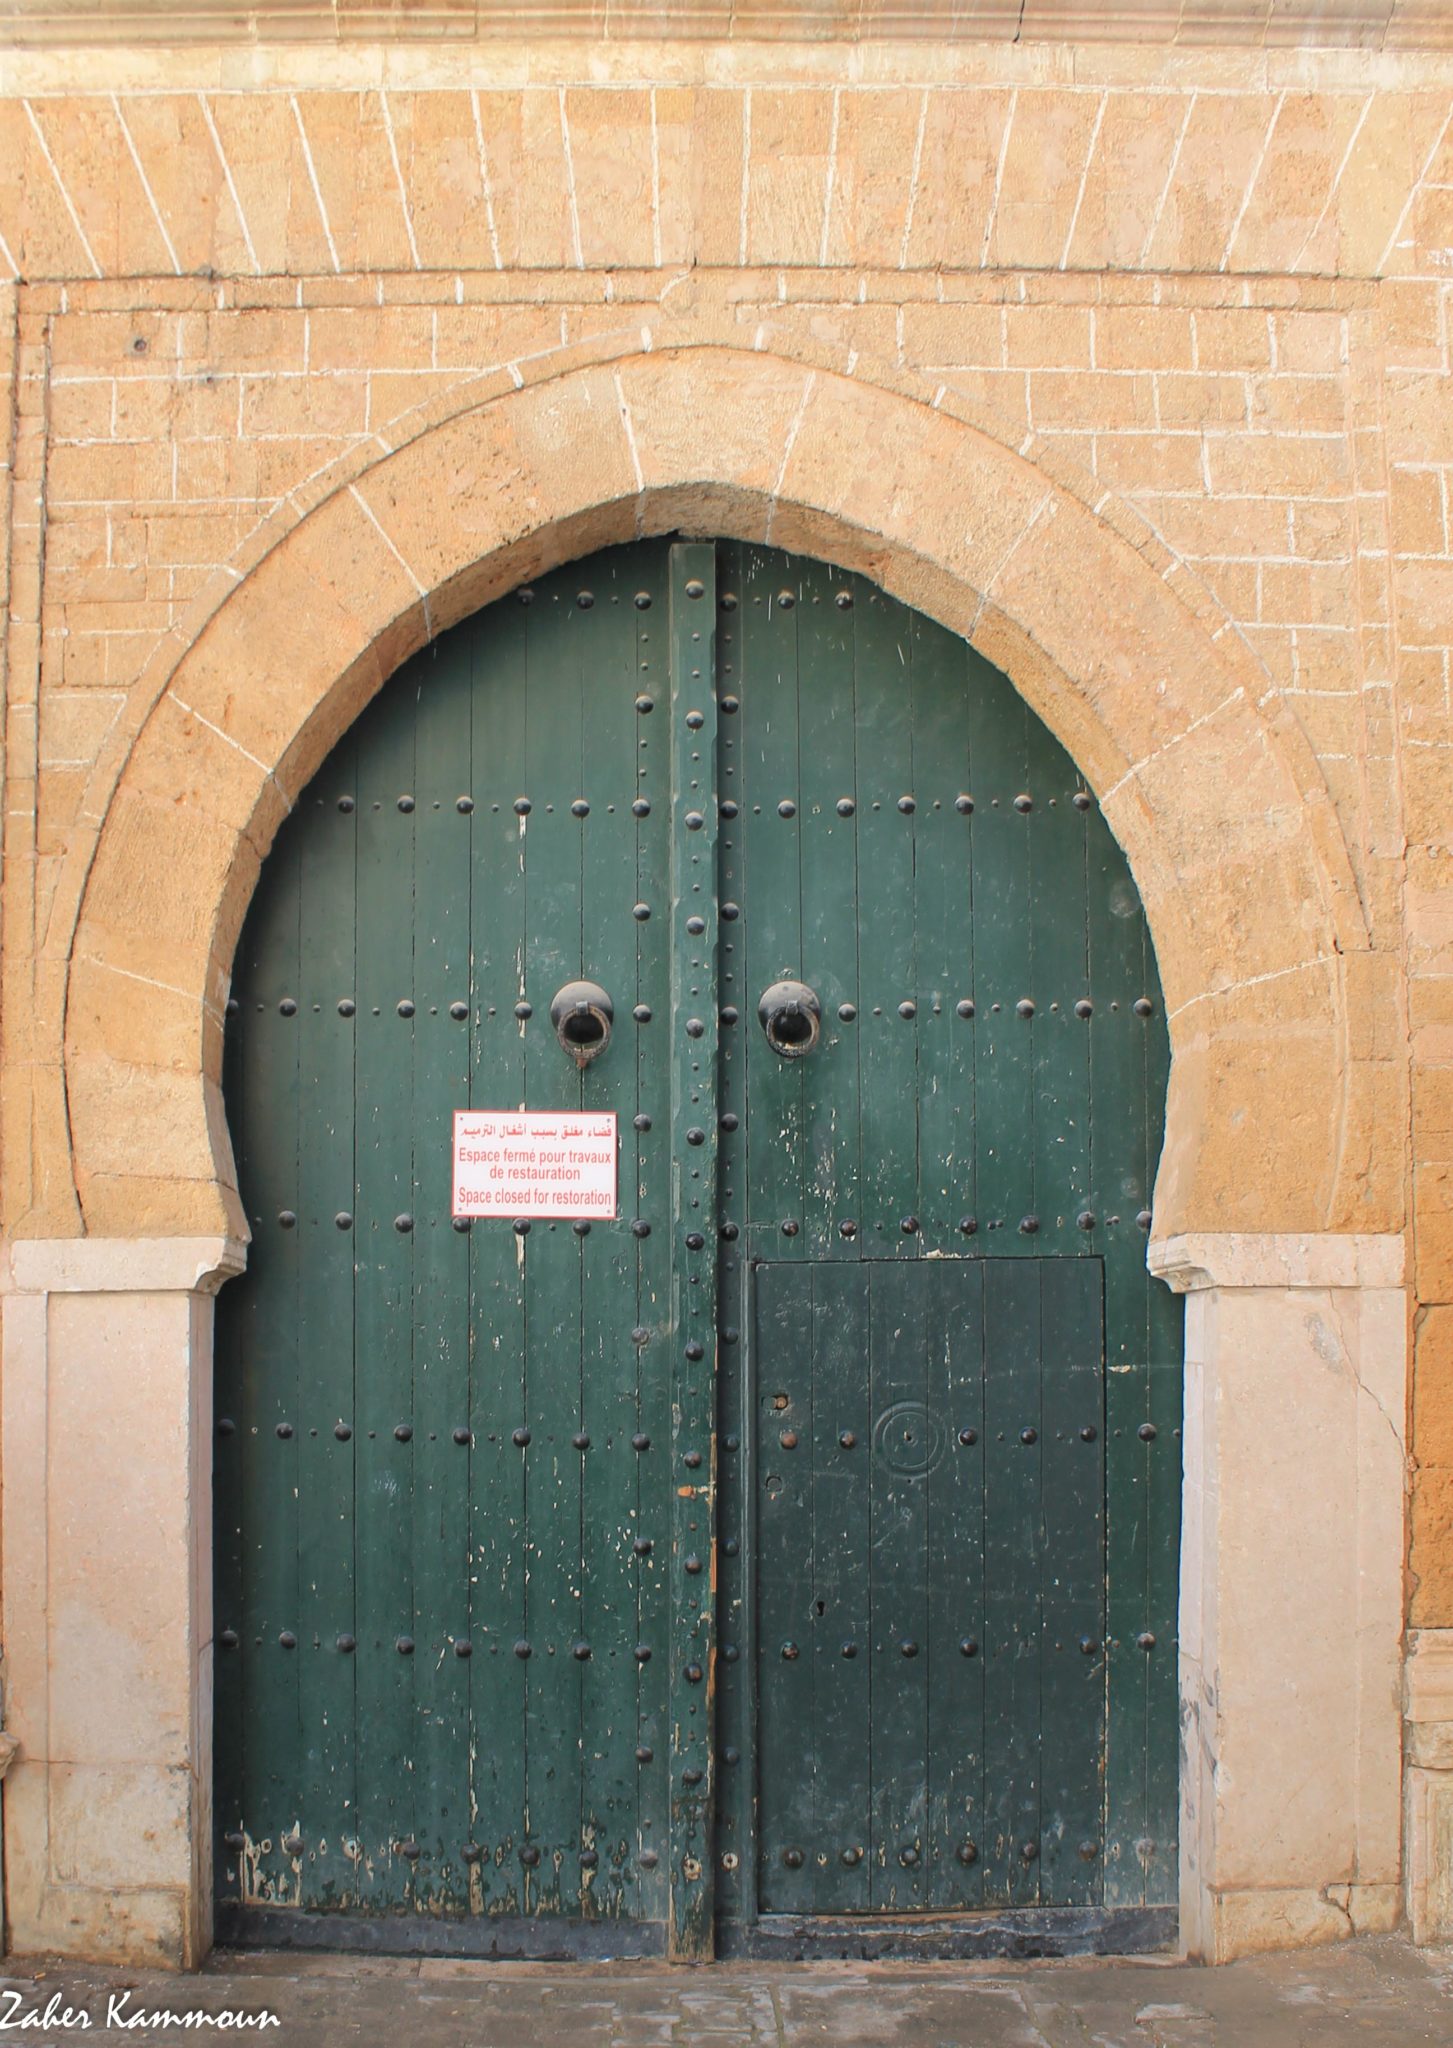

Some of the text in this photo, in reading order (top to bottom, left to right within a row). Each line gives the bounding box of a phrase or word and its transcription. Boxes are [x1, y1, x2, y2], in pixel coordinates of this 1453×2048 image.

[460, 1123, 612, 1141] فضاء مغلق بسبب أشغال الترميم
[459, 1147, 611, 1166] Espace fermé pour travaux
[489, 1165, 581, 1180] de restauration
[458, 1187, 611, 1207] Space closed for restoration
